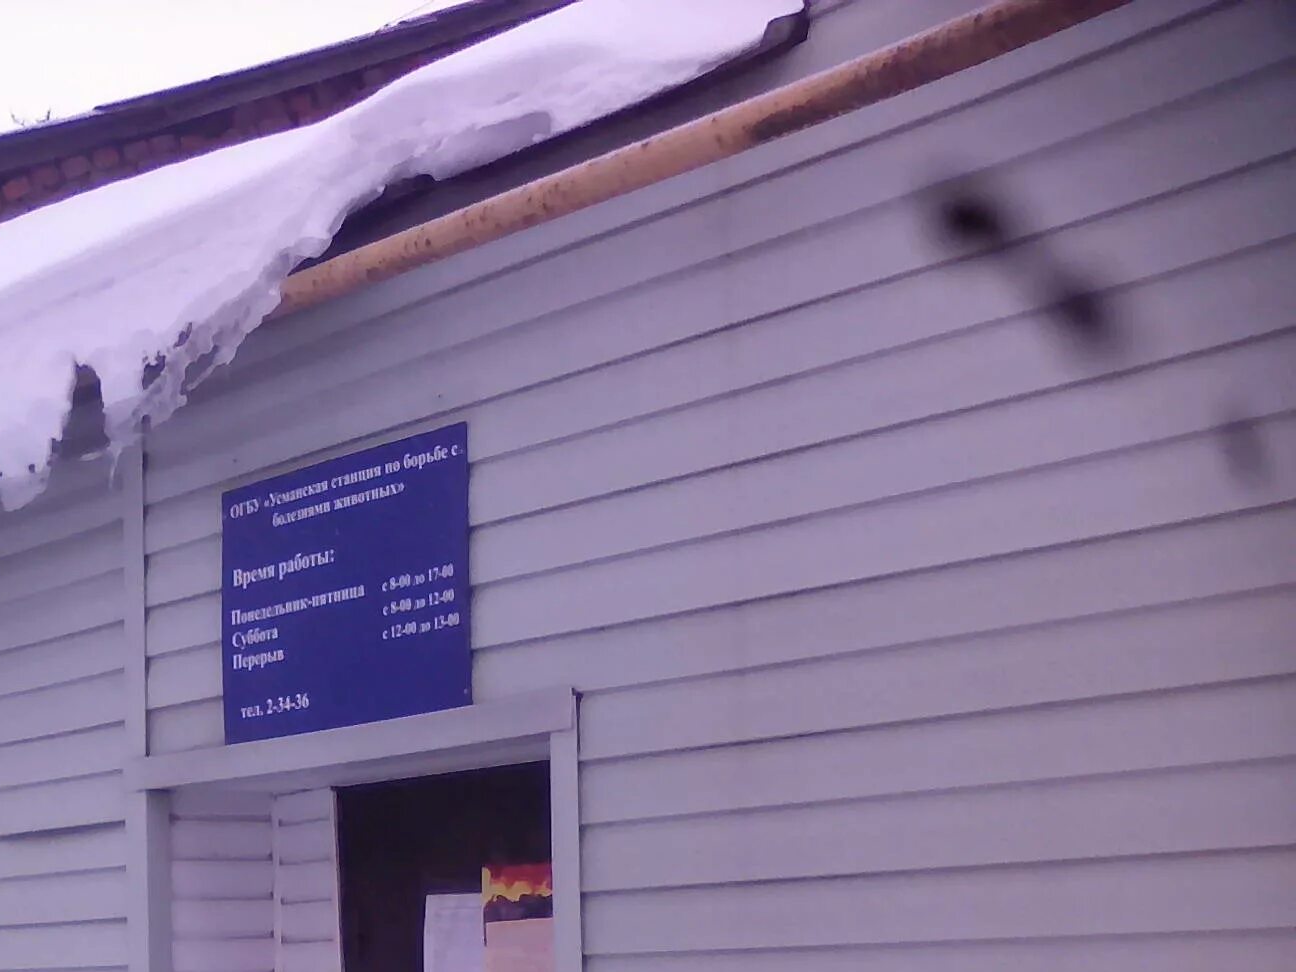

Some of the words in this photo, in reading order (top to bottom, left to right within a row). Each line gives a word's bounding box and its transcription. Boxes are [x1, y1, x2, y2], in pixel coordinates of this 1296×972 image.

[230, 498, 259, 519] ОГБУ
[331, 465, 381, 489] станция
[385, 460, 401, 475] по
[404, 445, 448, 469] борьбе
[272, 501, 331, 528] болезнями
[231, 585, 365, 625] Понедельник-пятница
[389, 573, 411, 590] 8-00
[428, 563, 454, 582] 17-00
[233, 564, 275, 589] Время
[278, 549, 335, 580] работы:
[232, 627, 278, 649] Суббота
[390, 598, 412, 614] 8-00
[232, 649, 285, 671] Перерыв
[391, 621, 417, 638] 12-00
[434, 612, 460, 630] 13-00
[241, 705, 264, 718] тел.
[266, 693, 310, 715] 2-34-36
